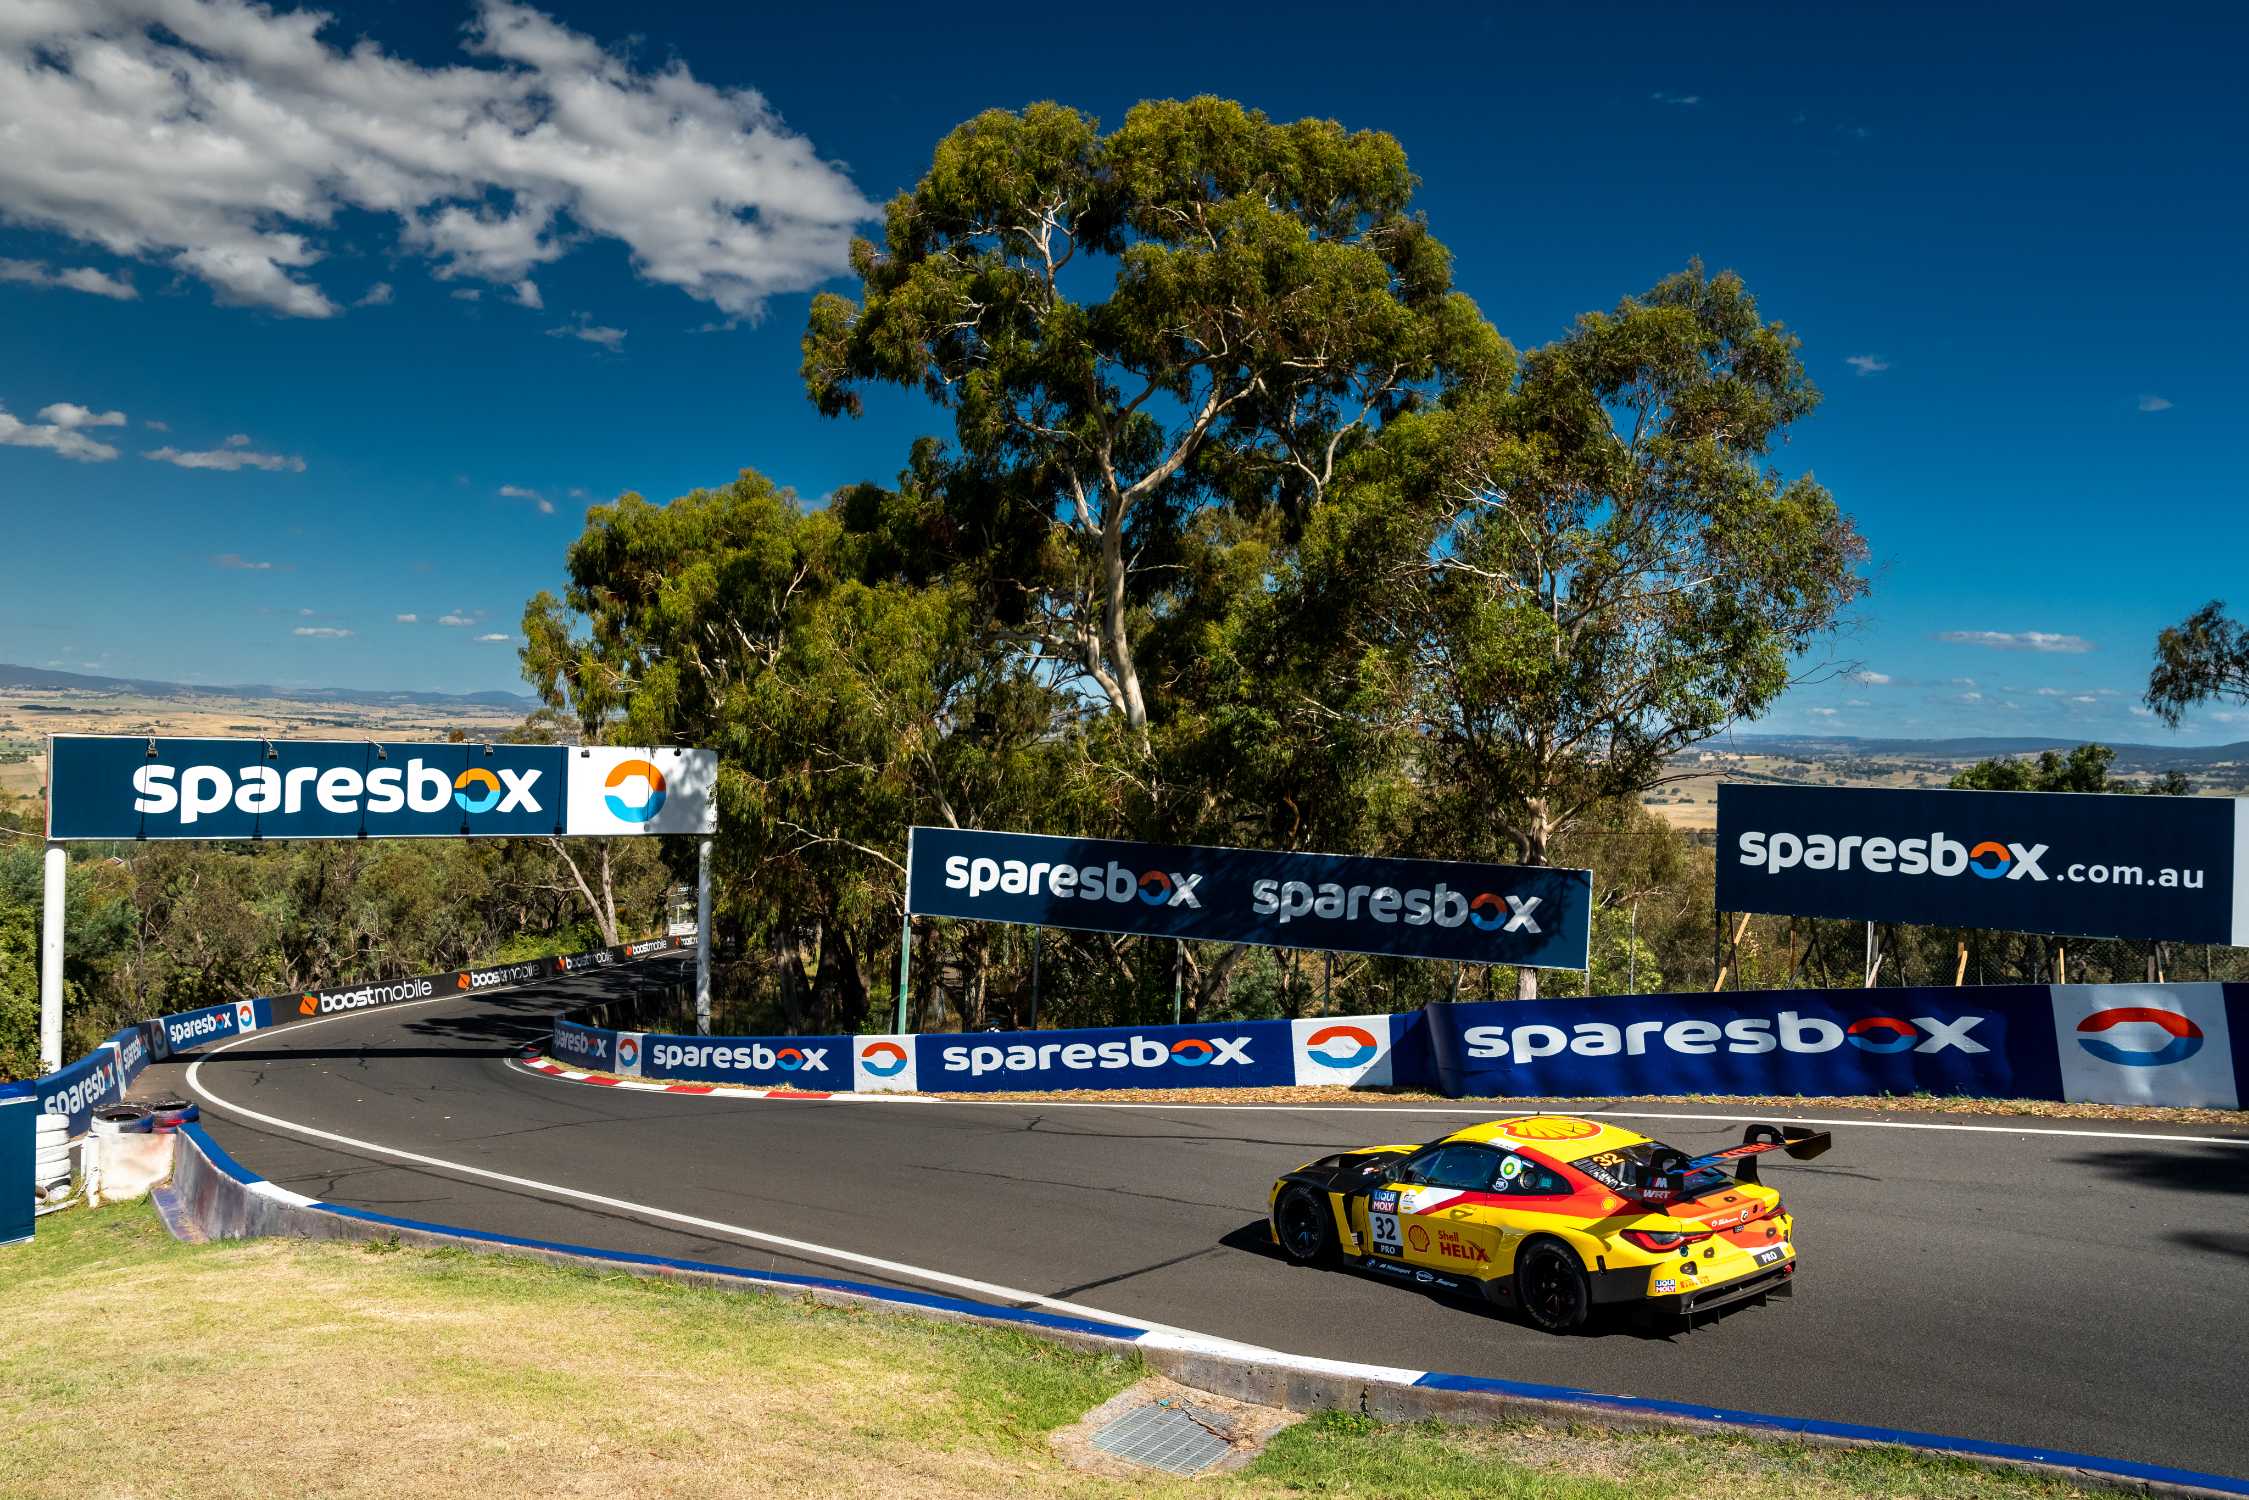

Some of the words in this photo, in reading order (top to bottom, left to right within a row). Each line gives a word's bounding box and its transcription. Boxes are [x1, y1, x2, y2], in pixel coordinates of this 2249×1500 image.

[132, 758, 543, 825] sparesbox
[945, 855, 1203, 909] sparesbox
[1252, 878, 1543, 934] sparesbox
[169, 1011, 233, 1043] sparesbox
[1463, 1011, 1991, 1064] sparesbox
[652, 1043, 830, 1072] sparesbox
[943, 1035, 1255, 1076] sparesbox
[1592, 1153, 1625, 1167] 32
[1373, 1201, 1395, 1211] MOLY
[1374, 1191, 1397, 1202] LIQUI
[1643, 1189, 1671, 1200] WRT
[1375, 1217, 1397, 1241] 32
[1438, 1230, 1459, 1242] Shell
[1380, 1245, 1396, 1254] PRO
[1440, 1240, 1492, 1263] HELIX
[1761, 1251, 1778, 1263] PRO
